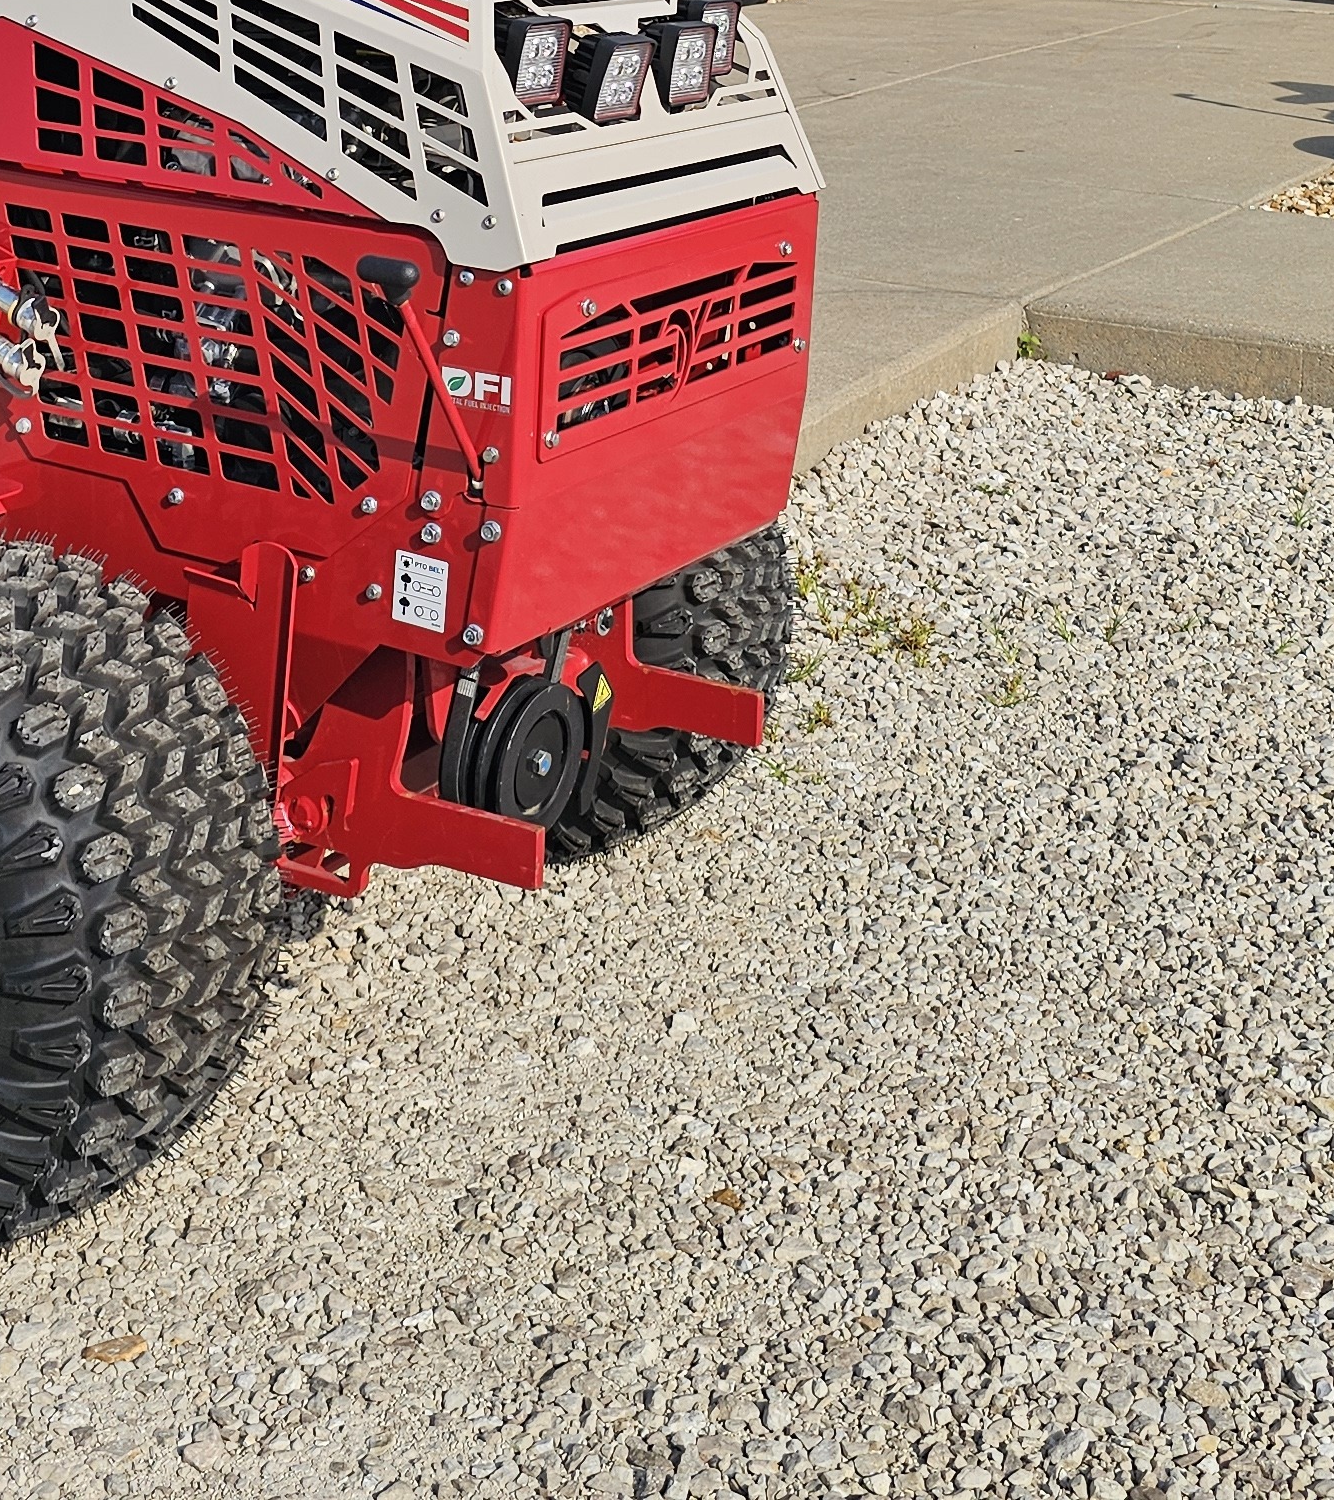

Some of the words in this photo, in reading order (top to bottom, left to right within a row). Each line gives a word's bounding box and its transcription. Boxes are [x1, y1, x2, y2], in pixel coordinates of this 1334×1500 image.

[441, 366, 512, 406] DFI
[463, 399, 479, 409] FUEL
[479, 401, 511, 414] INJECTION
[414, 561, 428, 570] PTO
[428, 565, 445, 575] BELT
